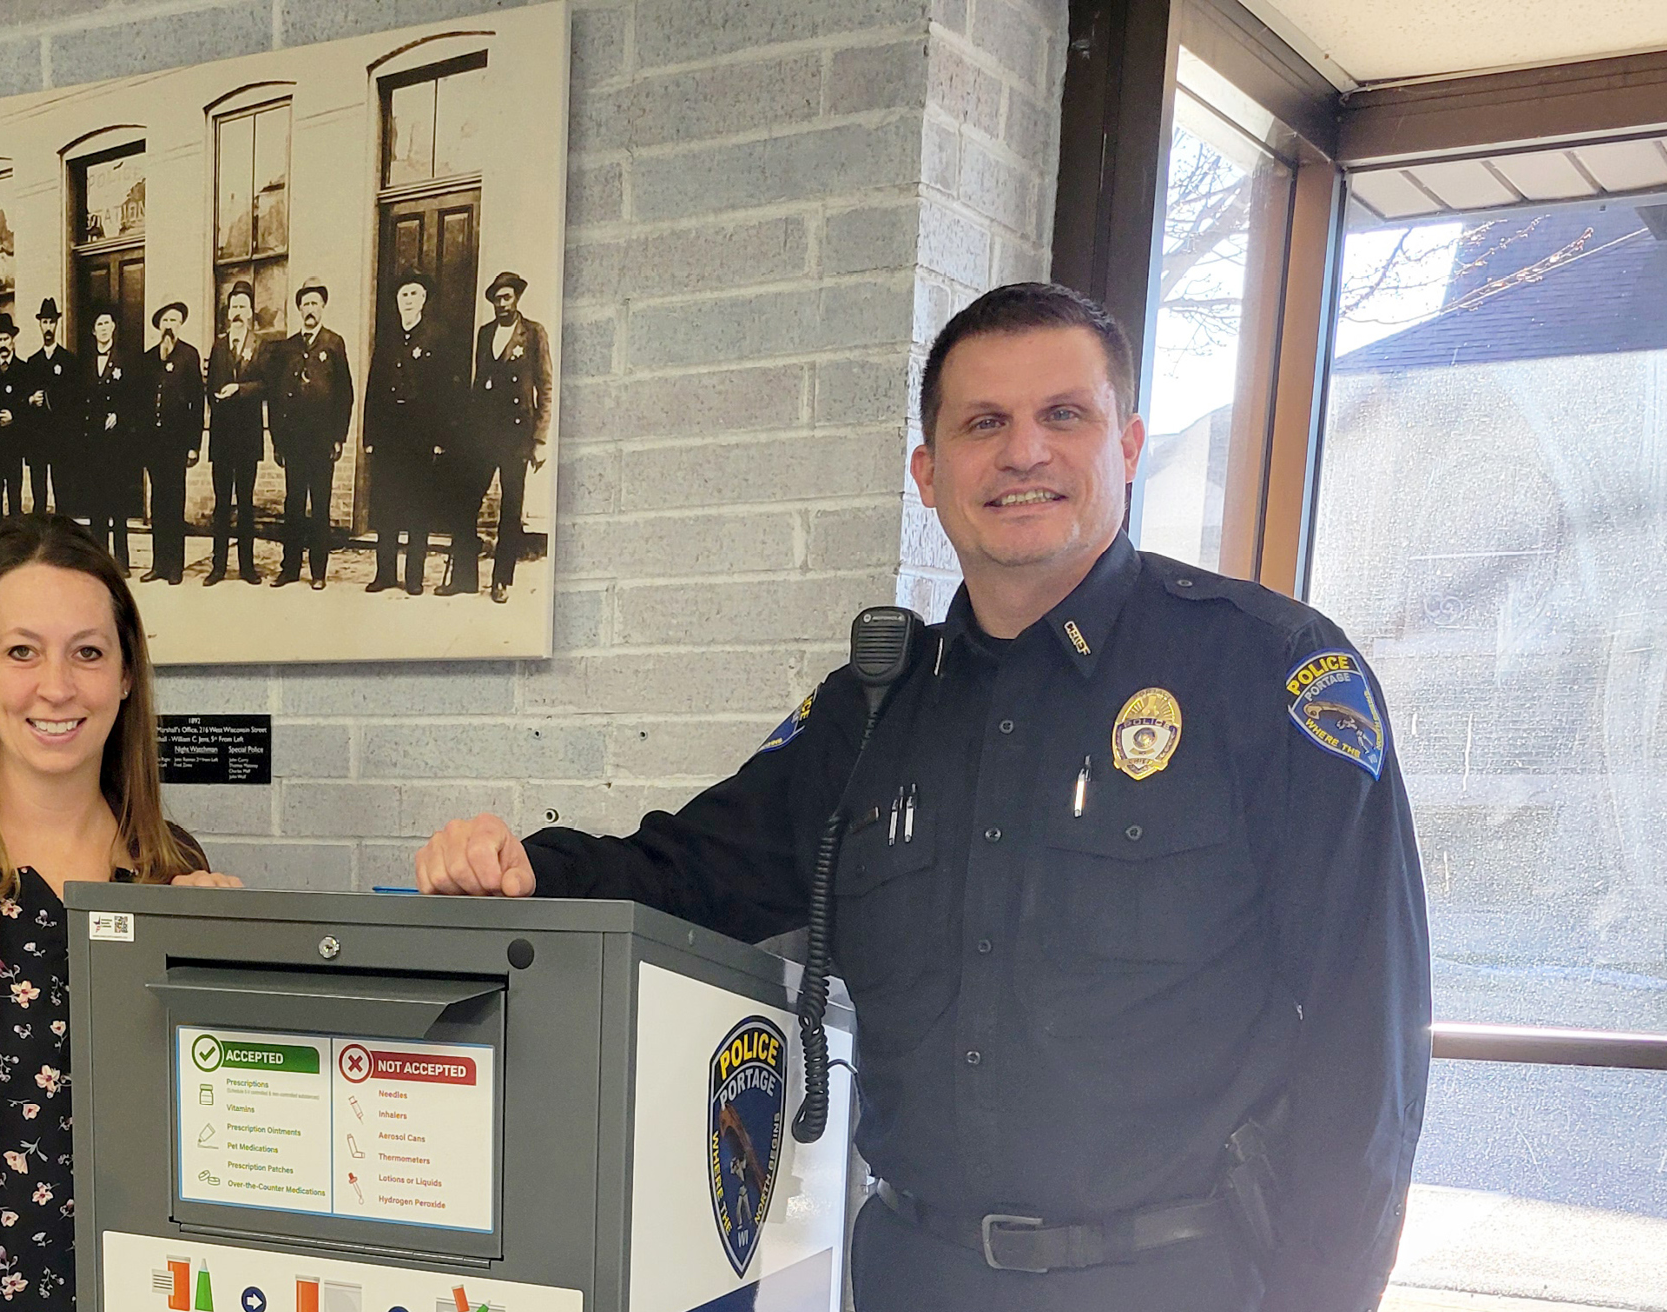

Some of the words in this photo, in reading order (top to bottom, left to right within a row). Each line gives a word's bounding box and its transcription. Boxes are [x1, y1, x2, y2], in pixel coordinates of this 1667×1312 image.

[1286, 655, 1350, 695] POLICE
[1304, 673, 1351, 701] PORTAGE
[1124, 719, 1170, 729] POLICE
[1305, 718, 1339, 747] WHERE
[226, 1050, 284, 1064] ACCEPTED
[720, 1032, 779, 1080] POLICE
[378, 1060, 402, 1073] NOT
[403, 1062, 467, 1078] ACCEPTED
[227, 1078, 269, 1088] Prescriptions
[720, 1068, 776, 1111] PORTAGE
[378, 1090, 408, 1099] Needles
[227, 1104, 255, 1113] Vitamins
[378, 1110, 407, 1120] Inhalers
[227, 1123, 266, 1134] Prescription
[267, 1126, 301, 1136] Ointments
[378, 1132, 405, 1141] Aerosol
[407, 1134, 425, 1142] Cans
[227, 1142, 237, 1150] Pet
[239, 1144, 279, 1154] Medications
[378, 1153, 431, 1164] Thermometers
[227, 1161, 267, 1172] Prescription
[268, 1165, 293, 1174] Patches
[713, 1130, 724, 1202] WHERE
[379, 1174, 405, 1184] Lotions
[415, 1178, 442, 1187] Liquids
[227, 1180, 285, 1192] Over-the-Counter
[285, 1186, 325, 1196] Medications
[378, 1195, 413, 1206] Hydrogen
[415, 1199, 446, 1208] Peroxide
[755, 1174, 771, 1225] NORTH
[720, 1201, 733, 1236] THE
[737, 1230, 749, 1248] WI
